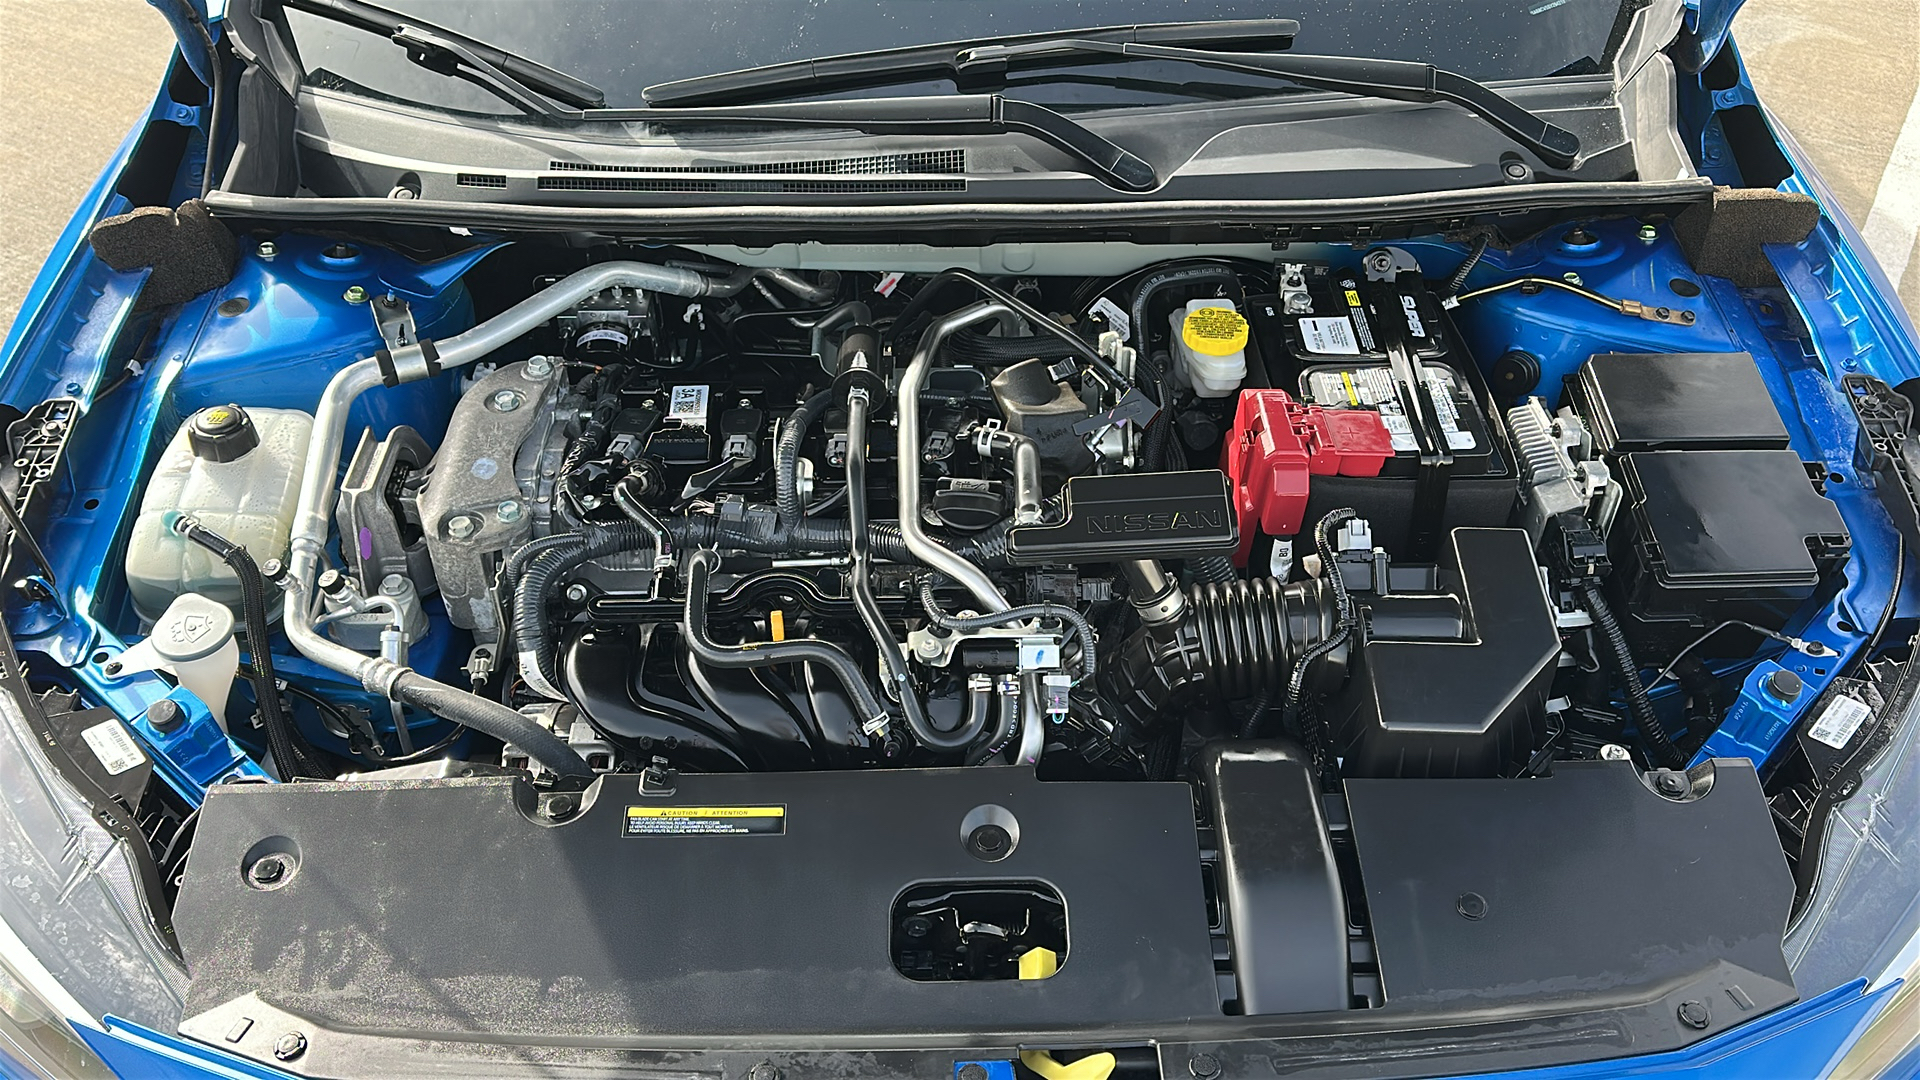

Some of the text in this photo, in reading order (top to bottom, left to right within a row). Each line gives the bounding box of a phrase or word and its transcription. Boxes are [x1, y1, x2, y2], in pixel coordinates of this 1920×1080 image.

[1399, 295, 1426, 338] SUPER
[681, 388, 695, 399] 3A
[1087, 510, 1222, 533] NISSAN
